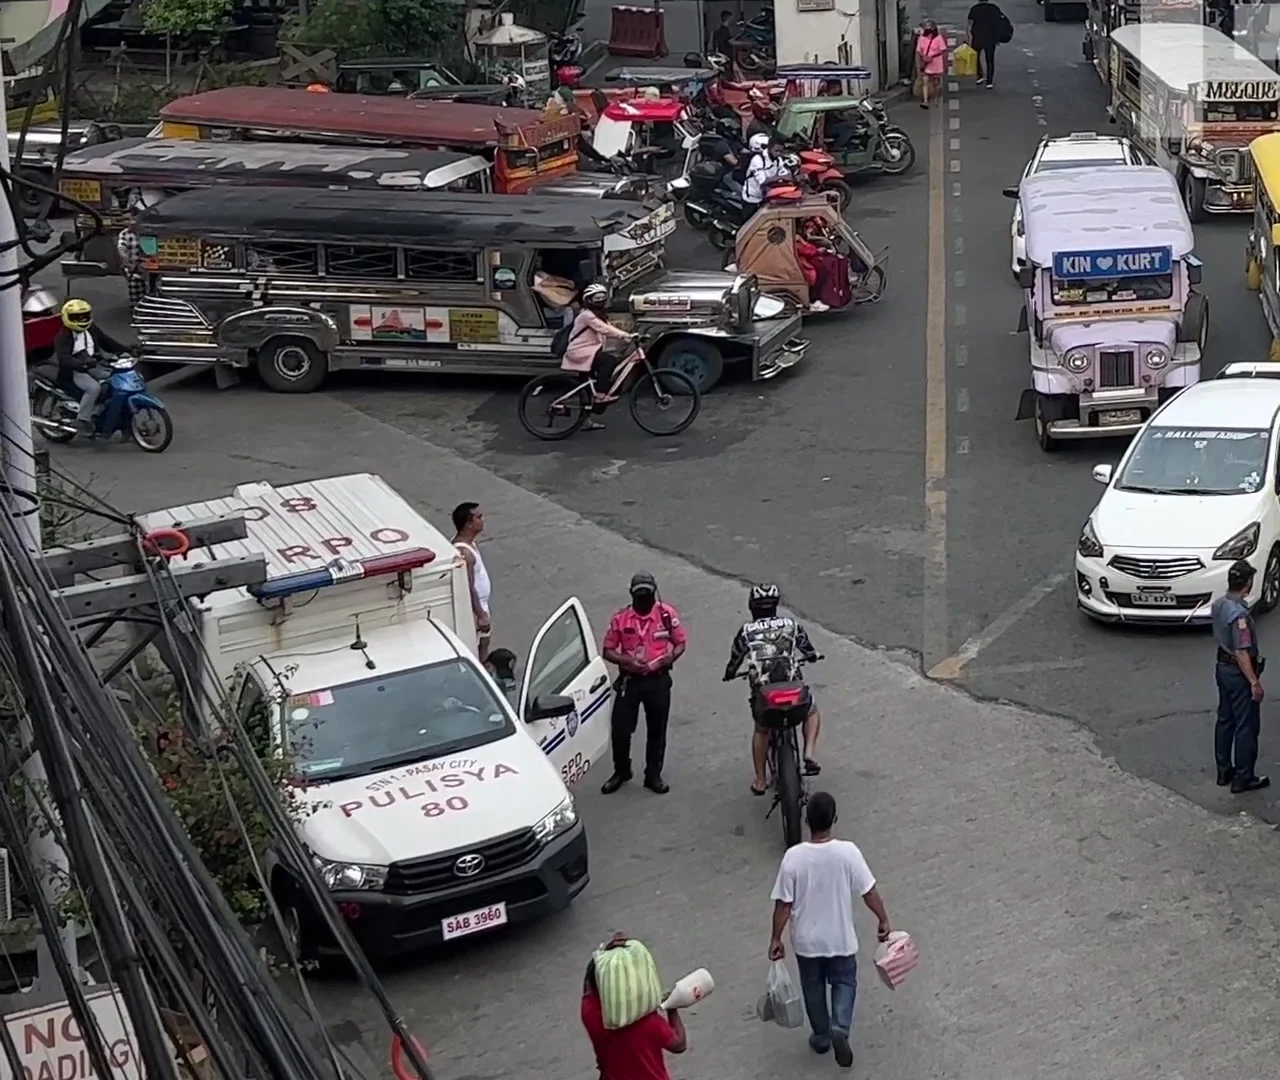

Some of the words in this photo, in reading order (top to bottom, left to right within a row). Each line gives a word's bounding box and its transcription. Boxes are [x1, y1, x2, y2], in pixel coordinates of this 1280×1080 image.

[1062, 256, 1092, 273] KIN
[1116, 252, 1162, 271] KURT
[449, 759, 478, 770] CITY
[338, 763, 519, 819] PULISYA
[420, 796, 469, 818] 80
[447, 920, 470, 933] SAB
